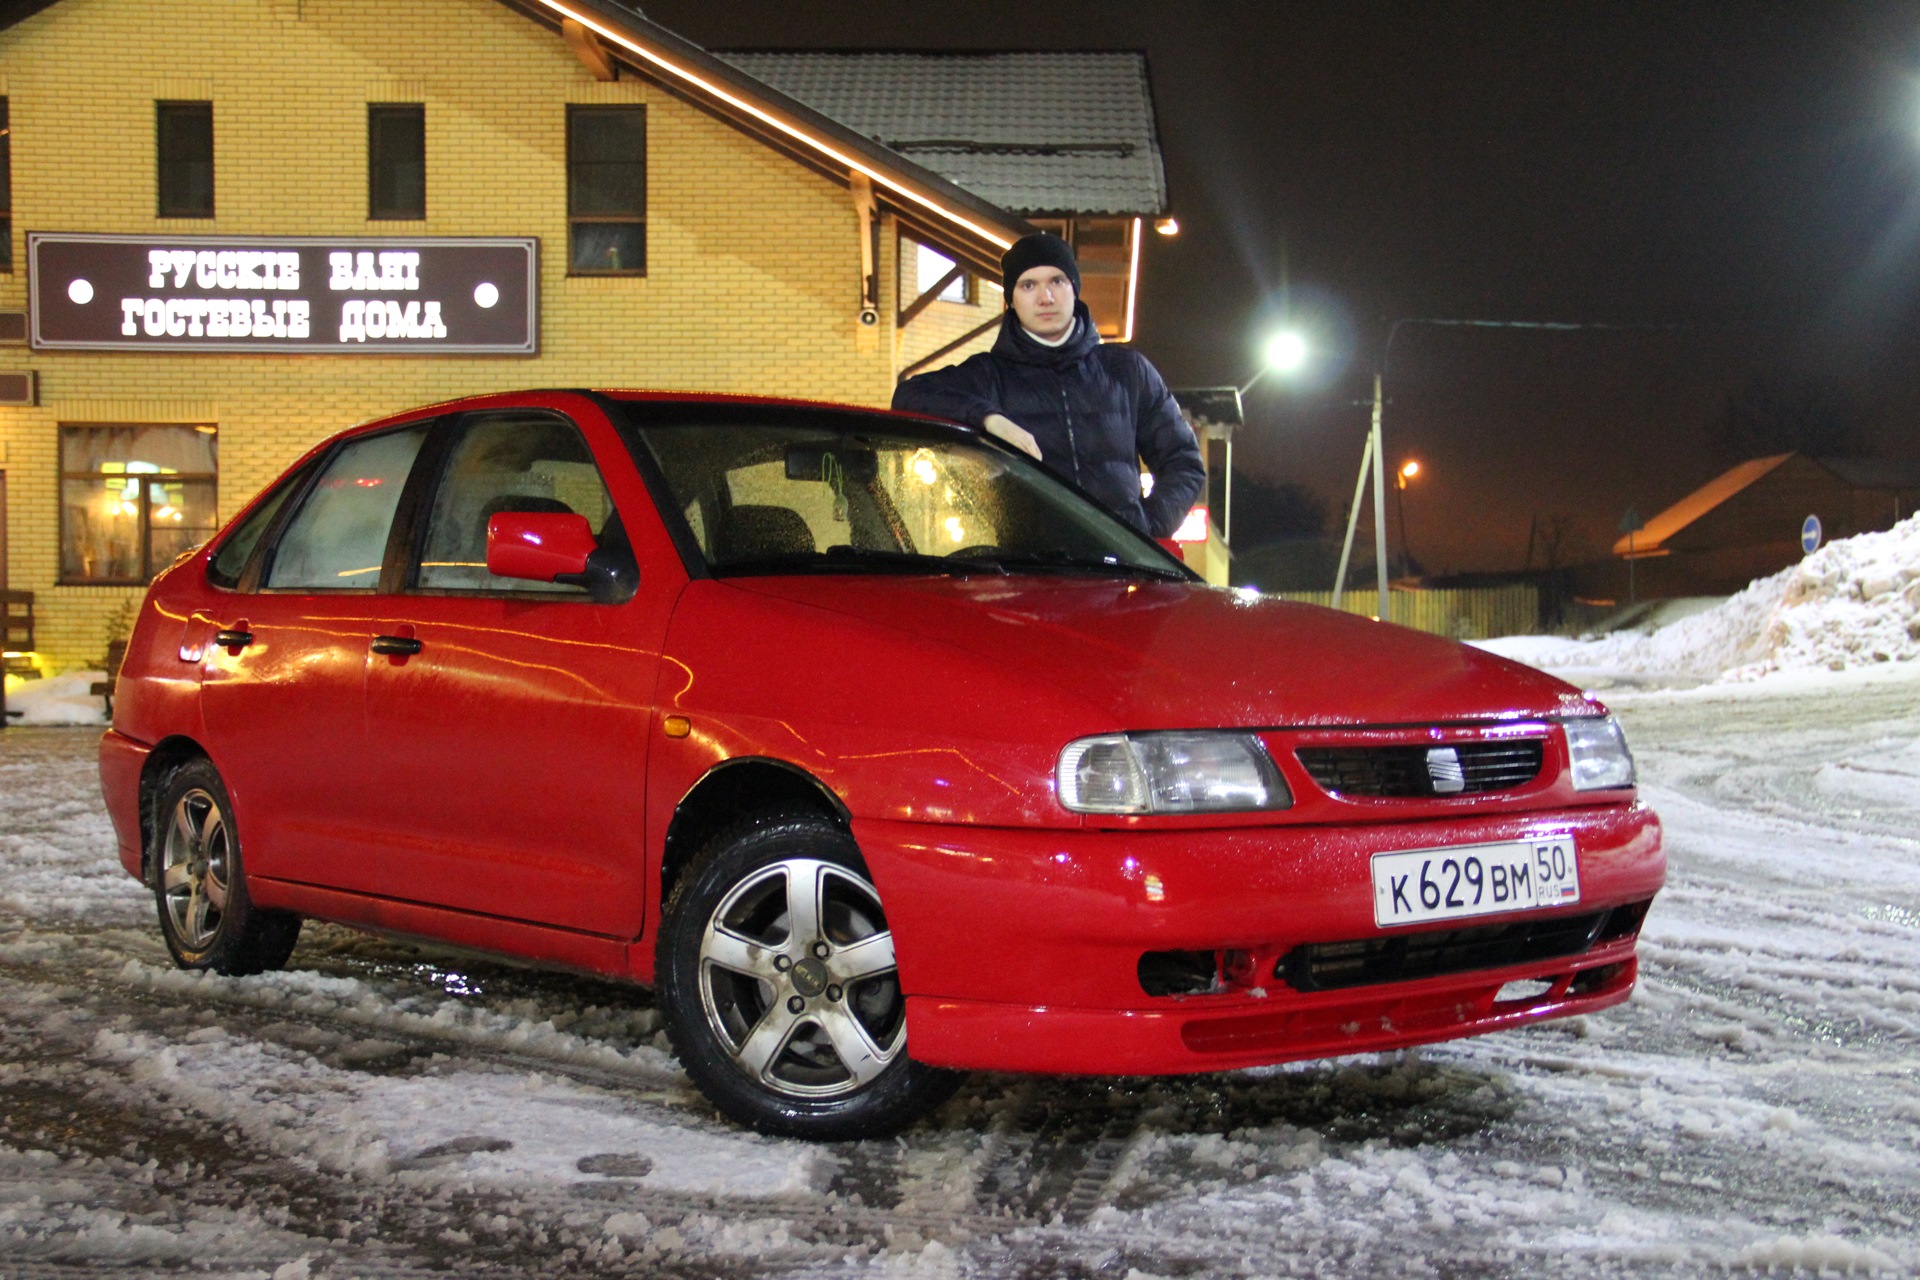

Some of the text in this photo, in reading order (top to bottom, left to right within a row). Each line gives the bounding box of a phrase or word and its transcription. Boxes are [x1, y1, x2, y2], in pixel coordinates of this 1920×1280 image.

[121, 298, 447, 343] ГОСТЕВЫЕ ДОМА
[1537, 845, 1566, 882] 50
[1538, 884, 1560, 898] RUS
